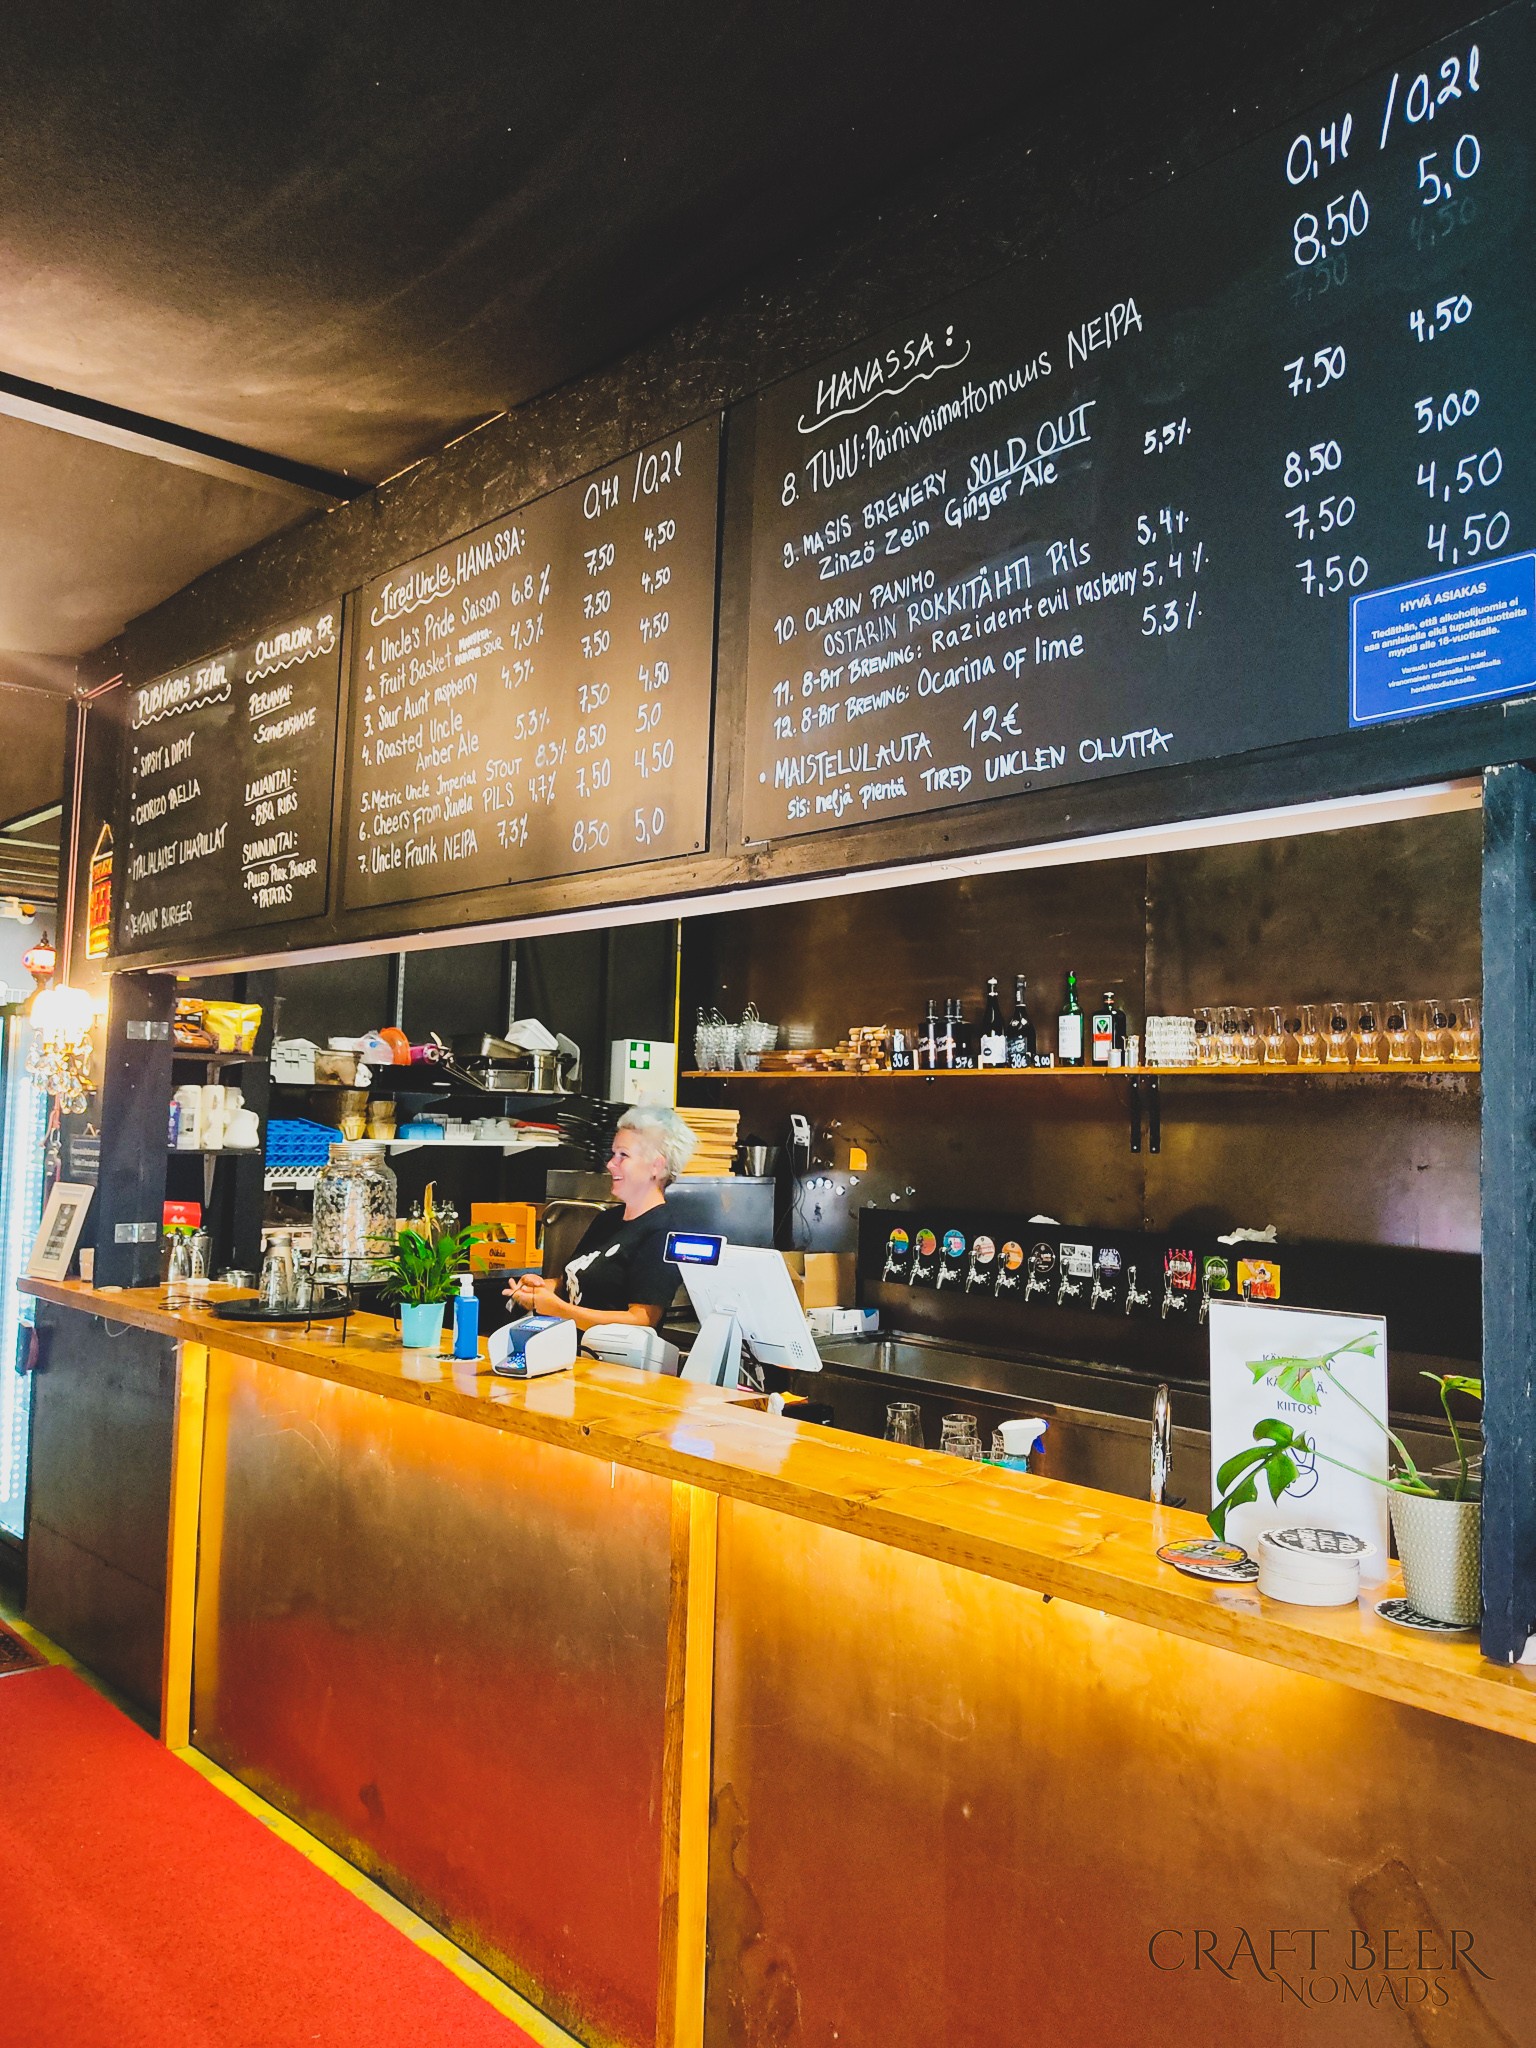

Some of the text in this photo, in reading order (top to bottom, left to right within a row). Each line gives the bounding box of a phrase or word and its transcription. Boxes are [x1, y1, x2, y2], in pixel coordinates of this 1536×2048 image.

[1294, 189, 1369, 266] 8,50
[1419, 134, 1480, 205] 5,0
[1284, 294, 1473, 397] 7,50 4,50
[781, 472, 799, 507] 8.
[1066, 297, 1143, 369] NEIPA
[1283, 389, 1480, 488] 8,50 5,00
[783, 542, 799, 569] 9.
[802, 514, 852, 556] MASIS
[862, 469, 947, 529] BREWERY
[966, 437, 1026, 492] SOLD
[1036, 400, 1096, 455] OUT
[818, 460, 1059, 580] Zinzö Zein Ginger Ale
[1285, 447, 1502, 540] 7,50 4,50
[365, 646, 376, 672] 1.
[381, 627, 420, 664] Uncle's
[425, 607, 455, 647] Pride
[461, 590, 501, 625] Saison
[583, 543, 615, 577] 7,50
[644, 519, 676, 552] 4,50
[381, 576, 413, 615] Tired
[456, 527, 526, 586] HANASSA:
[583, 590, 611, 619] 7,50
[641, 566, 671, 595] 4,50
[823, 538, 1092, 657] OSTARIN ROKKITÄHTI Pils
[1295, 510, 1510, 597] 7,50 4,50
[1400, 582, 1487, 613] HYVÄ ASIAKAS
[772, 680, 794, 708] 11.
[931, 597, 1032, 654] Razident
[1037, 587, 1070, 618] evil
[1075, 568, 1137, 606] rasberry
[773, 615, 797, 645] 10.
[804, 592, 863, 632] OLARIN
[869, 569, 935, 610] PANIMO
[1364, 608, 1527, 652] saa anniskella eikä tupakkatuotteita
[1371, 596, 1519, 640] Tiedäthän, että alkoholijuomia ei
[1388, 627, 1500, 658] myydä alle 18-vuotiaalle.
[362, 745, 373, 766] 4.
[376, 724, 423, 765] Roasted
[429, 708, 463, 743] Uncle
[578, 682, 610, 713] 7,50
[638, 661, 669, 692] 4,50
[363, 713, 374, 738] 3.
[378, 705, 402, 731] Sour
[403, 688, 431, 721] Aunt
[434, 672, 478, 707] raspberry
[581, 629, 610, 659] 7,50
[639, 611, 669, 644] 4,50
[364, 685, 376, 703] 2.
[380, 663, 407, 698] Fruit
[409, 643, 453, 686] Basket
[773, 715, 797, 740] 12.
[917, 655, 996, 697] Ocarina
[1035, 634, 1085, 665] lime
[371, 789, 403, 810] Metric
[405, 780, 430, 800] Uncle
[436, 770, 477, 797] Imperial
[486, 757, 523, 782] STOUT
[575, 723, 607, 754] 8,50
[635, 702, 662, 733] 5,0
[415, 730, 480, 773] Amber Ale
[774, 702, 1023, 789] MAISTELULAUTA 12€
[787, 727, 1174, 820] sis: neljä pientä TIRED UNCLEN OLUTTA
[136, 795, 167, 826] CHORIZO
[255, 792, 298, 827] BBQ RIBS
[358, 821, 371, 842] 6.
[373, 809, 410, 837] Cheers
[443, 792, 473, 822] Suvela
[482, 781, 515, 813] PILS
[576, 758, 611, 797] 7,50
[634, 738, 674, 779] 4,50
[288, 858, 318, 880] BURGER
[358, 855, 369, 874] 7.
[371, 841, 402, 875] Uncle
[404, 835, 439, 870] Frank
[443, 828, 479, 862] NEIPA
[572, 819, 610, 853] 8,50
[634, 807, 665, 845] 5,0
[161, 900, 194, 930] BURGER
[1277, 1400, 1318, 1415] KIITOS!
